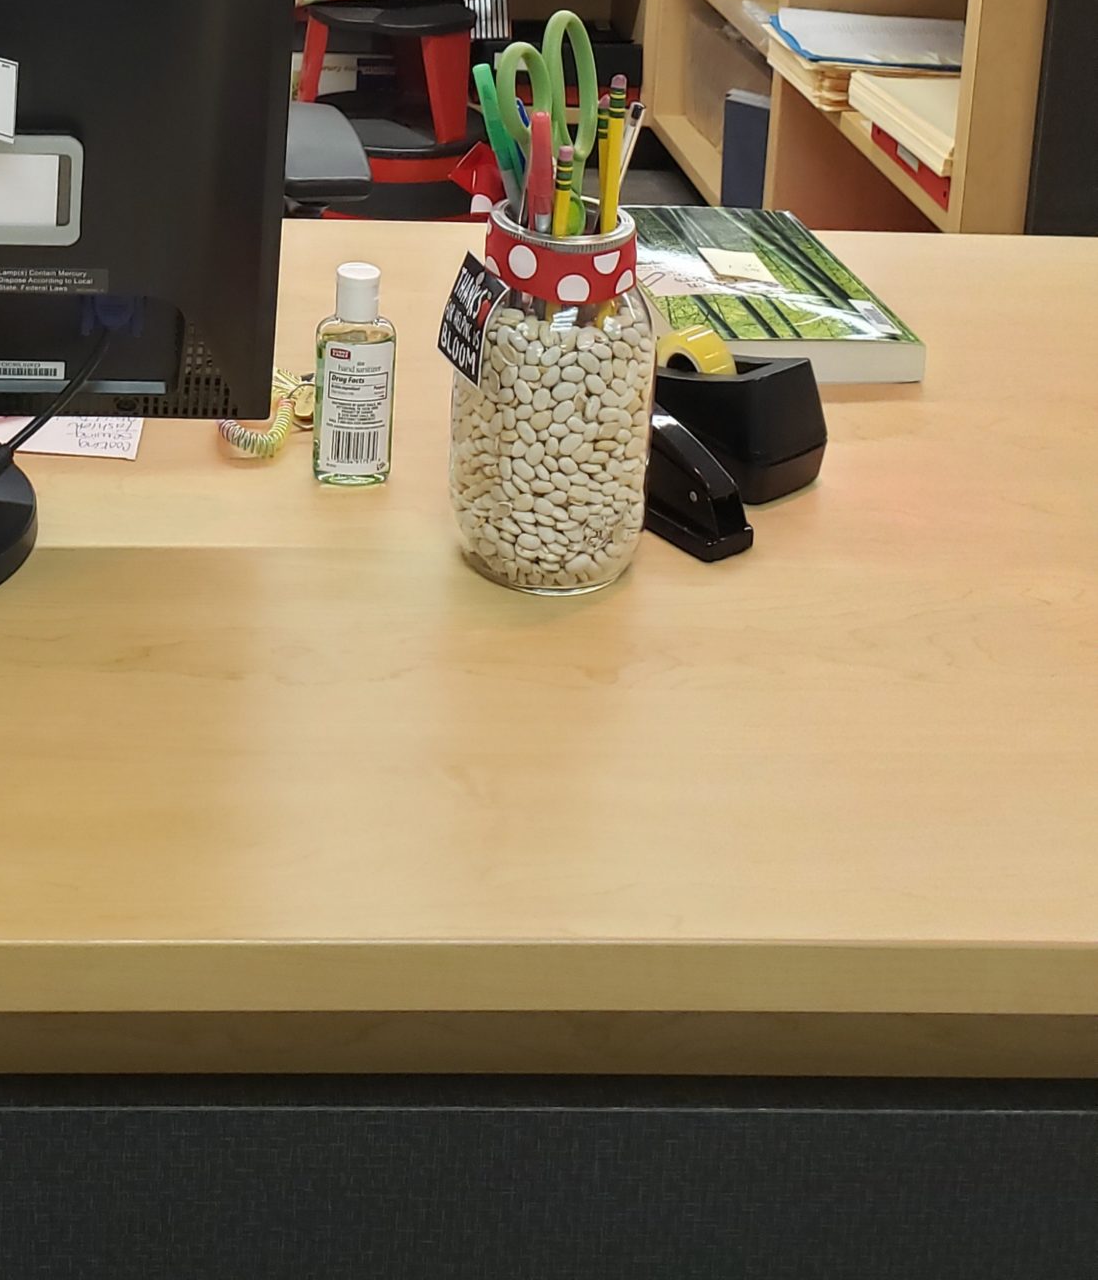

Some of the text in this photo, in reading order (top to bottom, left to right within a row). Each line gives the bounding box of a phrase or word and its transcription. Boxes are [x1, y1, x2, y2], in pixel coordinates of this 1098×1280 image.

[57, 270, 87, 278] Mercury
[28, 277, 64, 285] According
[454, 266, 488, 320] THANKS
[440, 322, 476, 376] BLOOM
[331, 374, 348, 384] Drug
